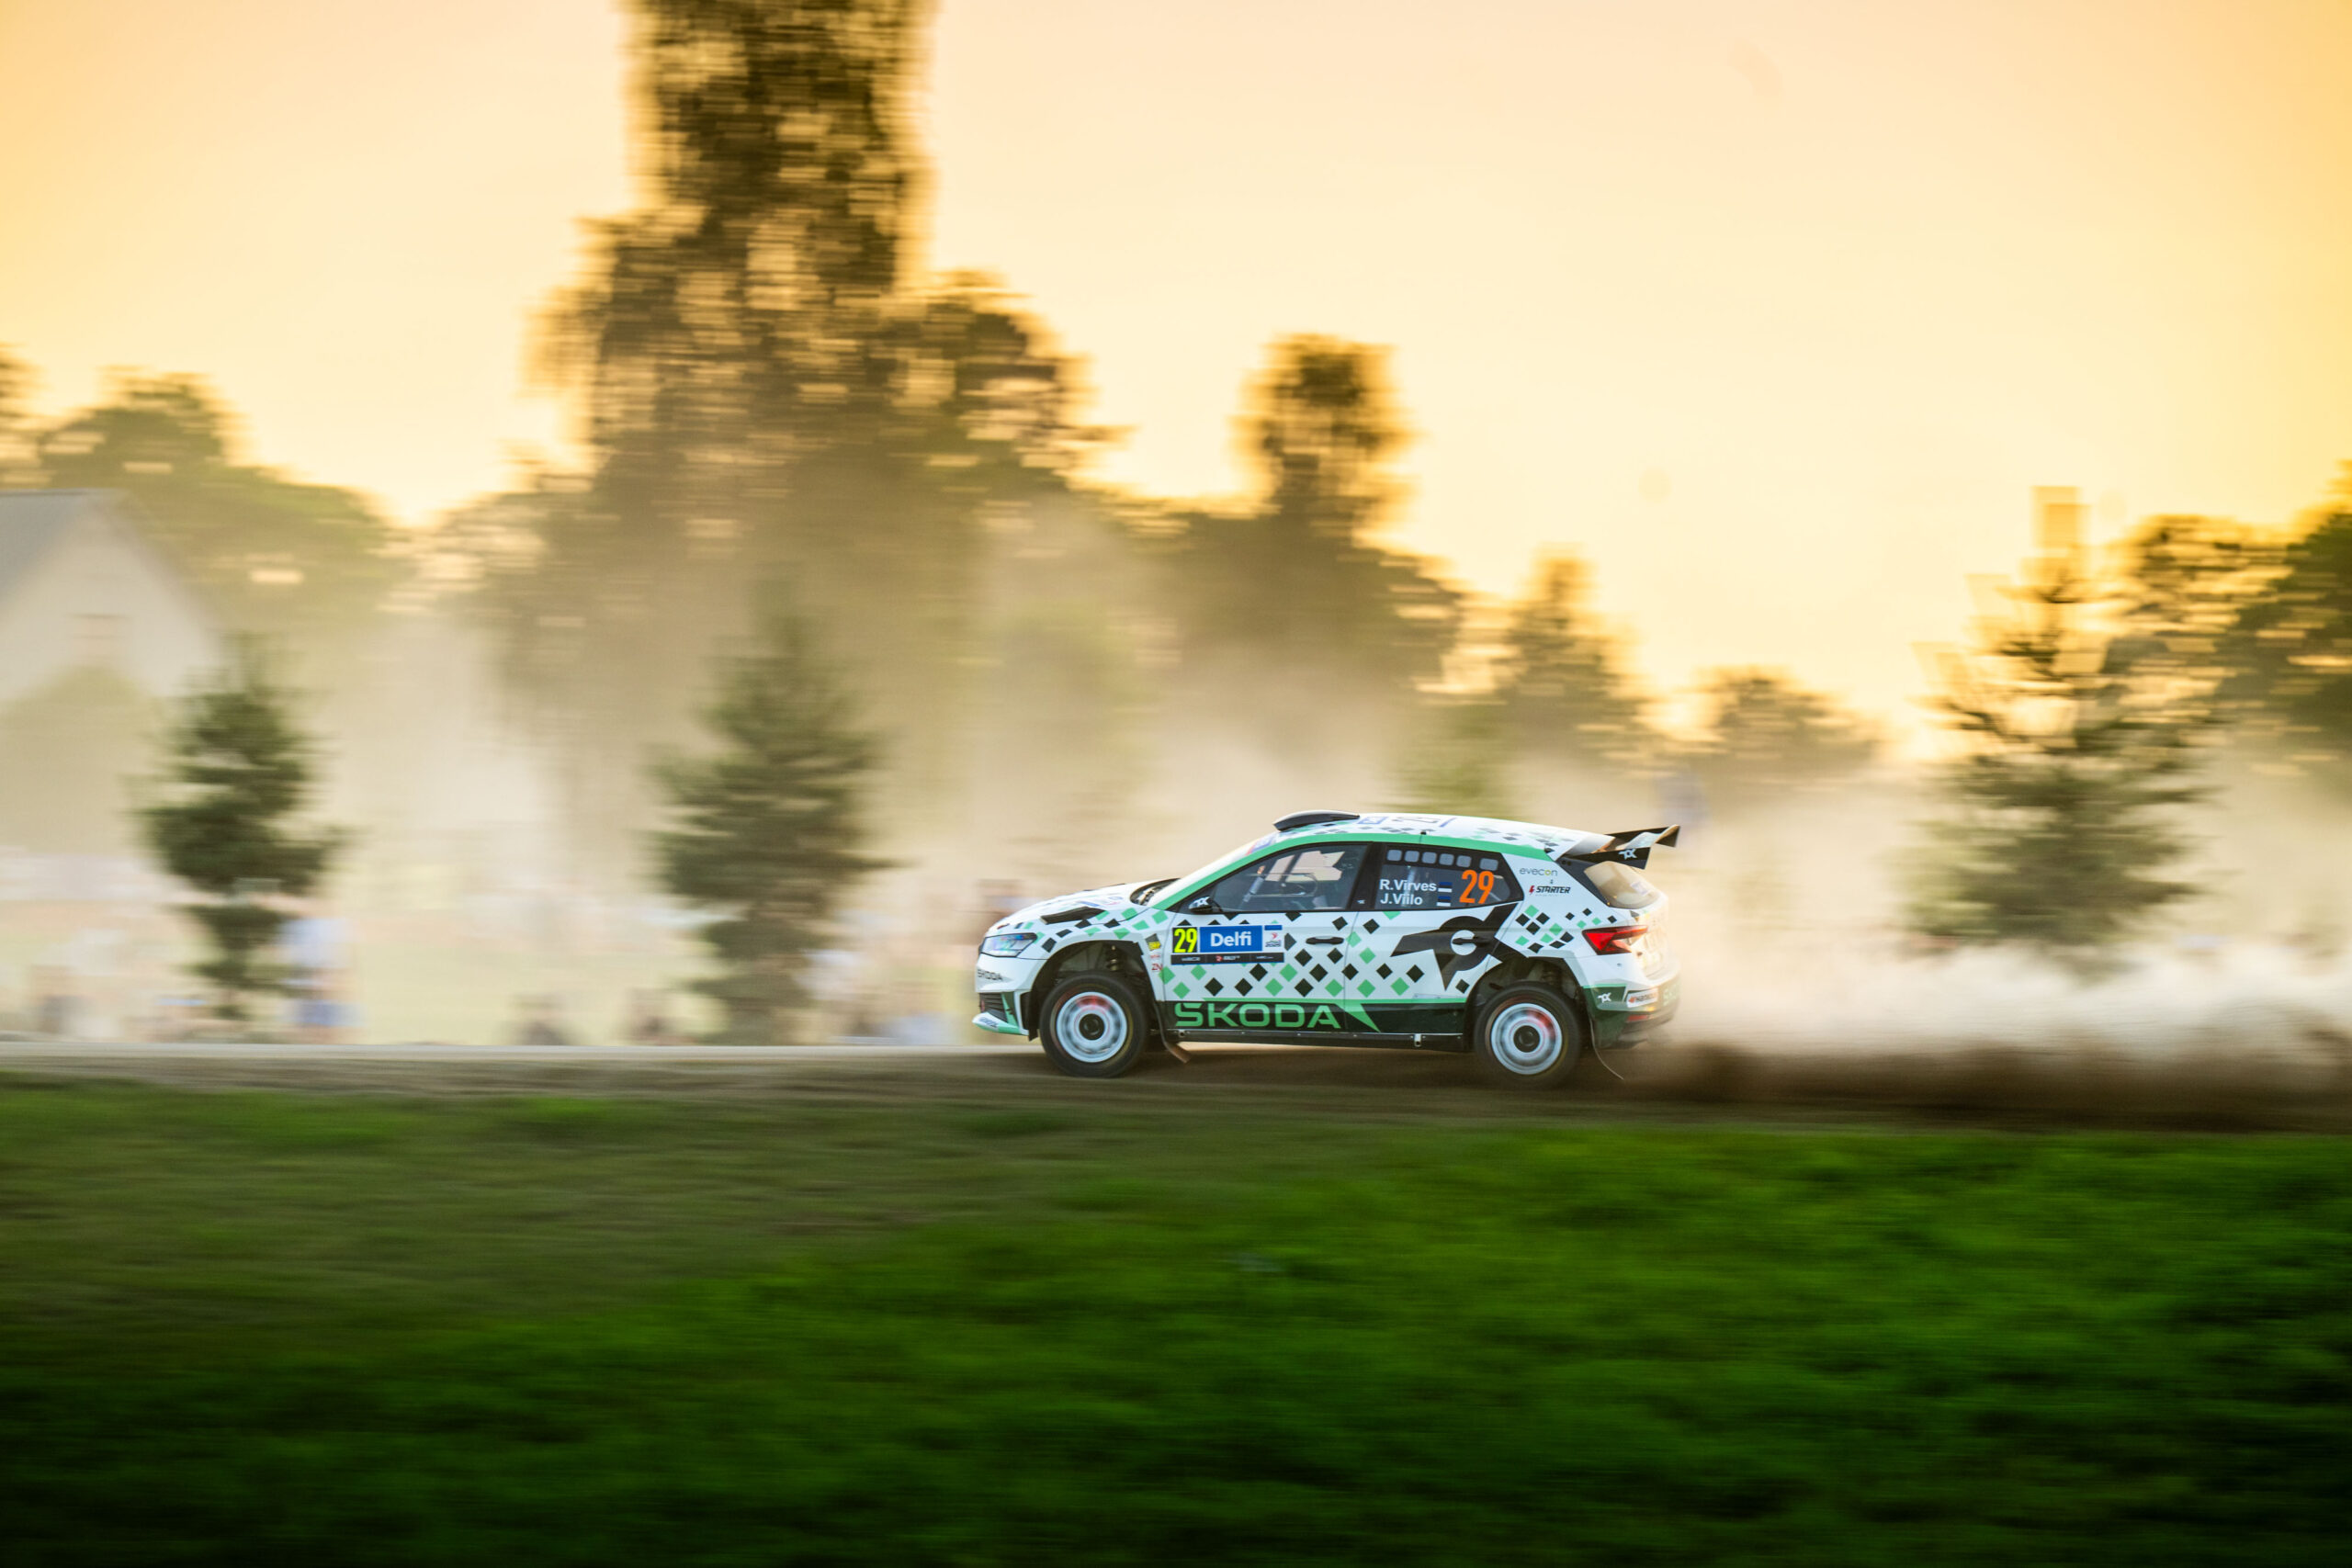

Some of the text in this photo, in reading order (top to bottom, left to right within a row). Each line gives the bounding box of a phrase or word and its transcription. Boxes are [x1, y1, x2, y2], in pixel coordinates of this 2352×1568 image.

[1519, 868, 1557, 876] evecon
[1379, 879, 1437, 891] R.Virves
[1459, 869, 1495, 904] 29
[1536, 886, 1570, 894] STARTER
[1380, 893, 1423, 905] J.Viilo
[1173, 928, 1198, 953] 29
[1210, 931, 1251, 947] Delfi
